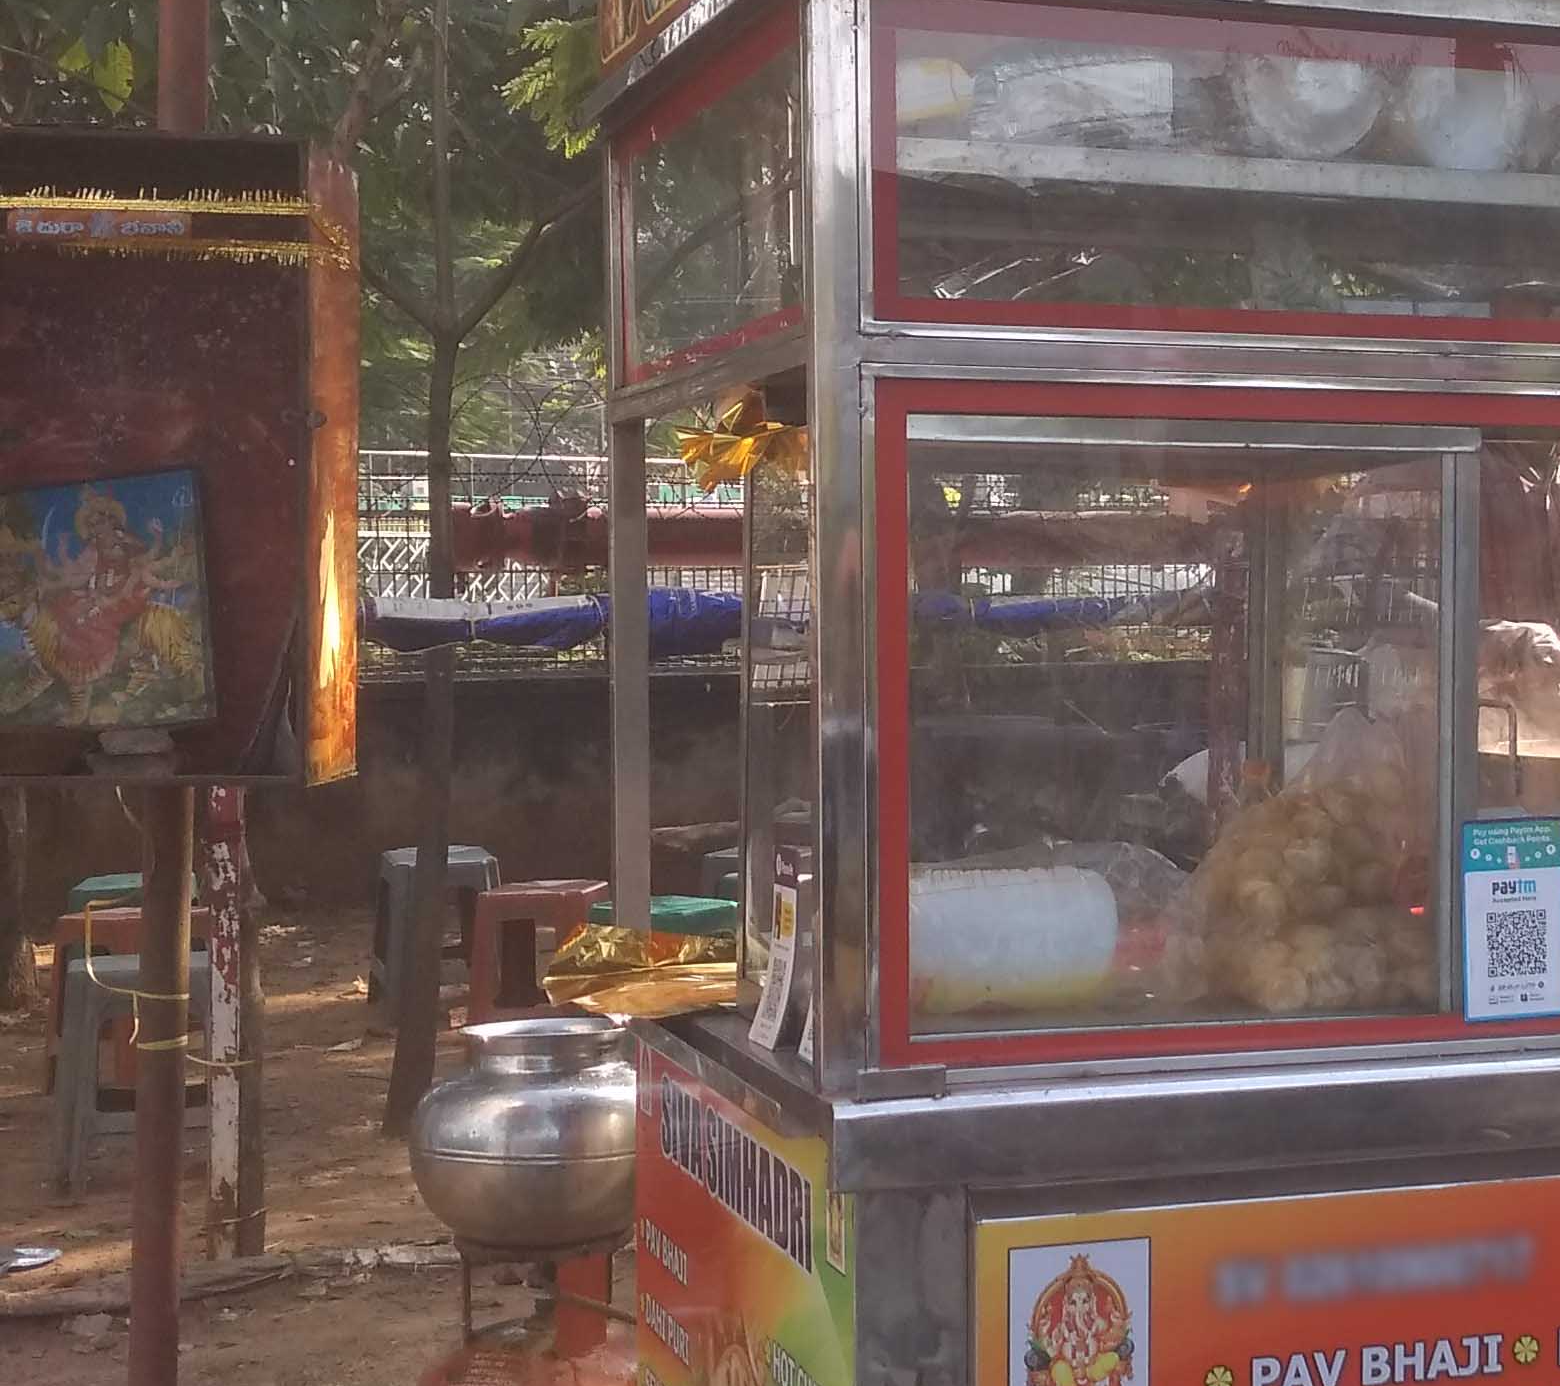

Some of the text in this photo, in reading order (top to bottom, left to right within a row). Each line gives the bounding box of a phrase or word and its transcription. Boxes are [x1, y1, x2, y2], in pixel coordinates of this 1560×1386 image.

[660, 1071, 814, 1277] SIVA SIMHADRI
[646, 1218, 688, 1286] PAV BHAJI
[645, 1293, 690, 1367] DAHI PURI
